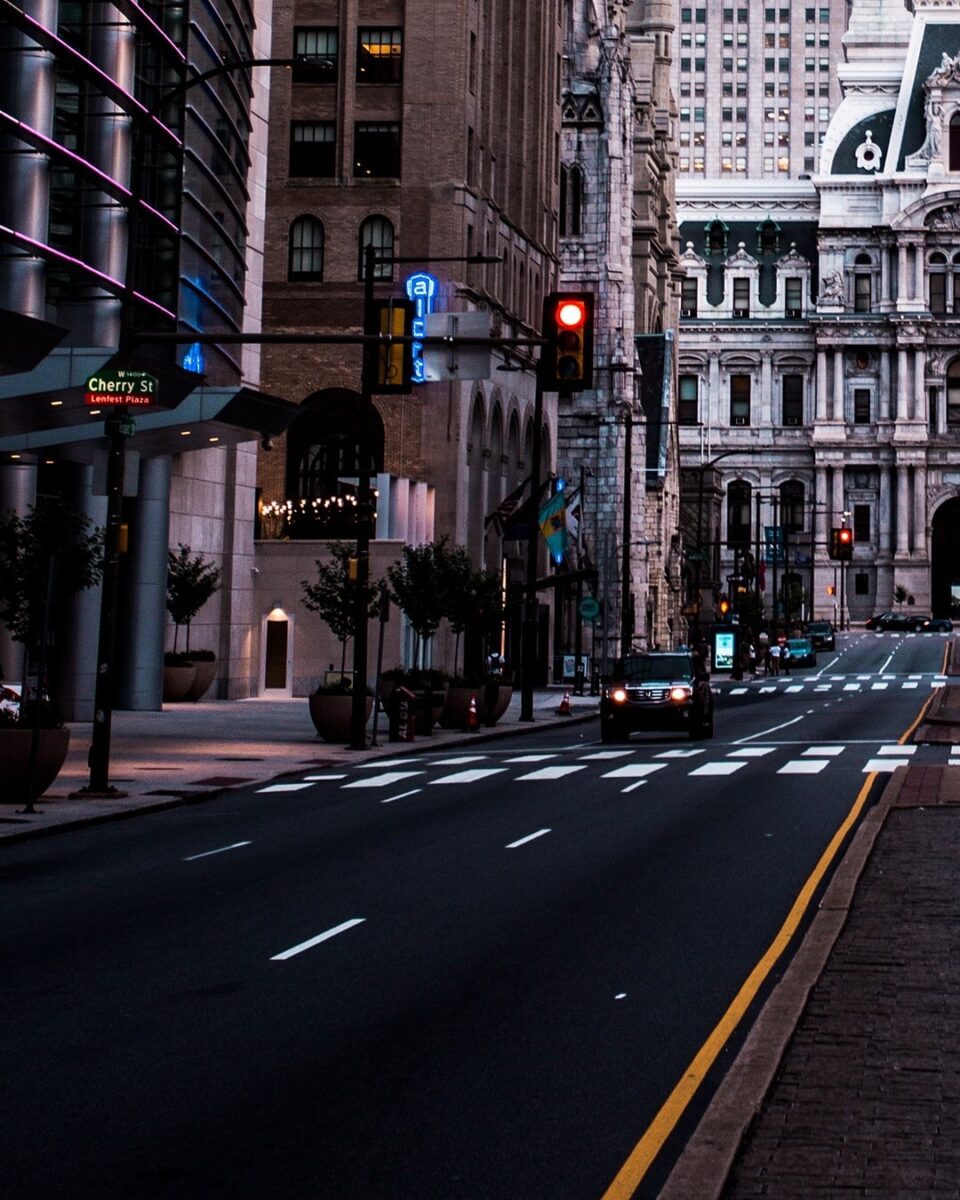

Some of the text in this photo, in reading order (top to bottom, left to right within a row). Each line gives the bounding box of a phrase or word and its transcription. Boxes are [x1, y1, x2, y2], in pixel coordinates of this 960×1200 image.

[118, 370, 126, 378] W
[88, 377, 153, 393] Cherry St
[90, 395, 149, 403] Lenfest Plaza
